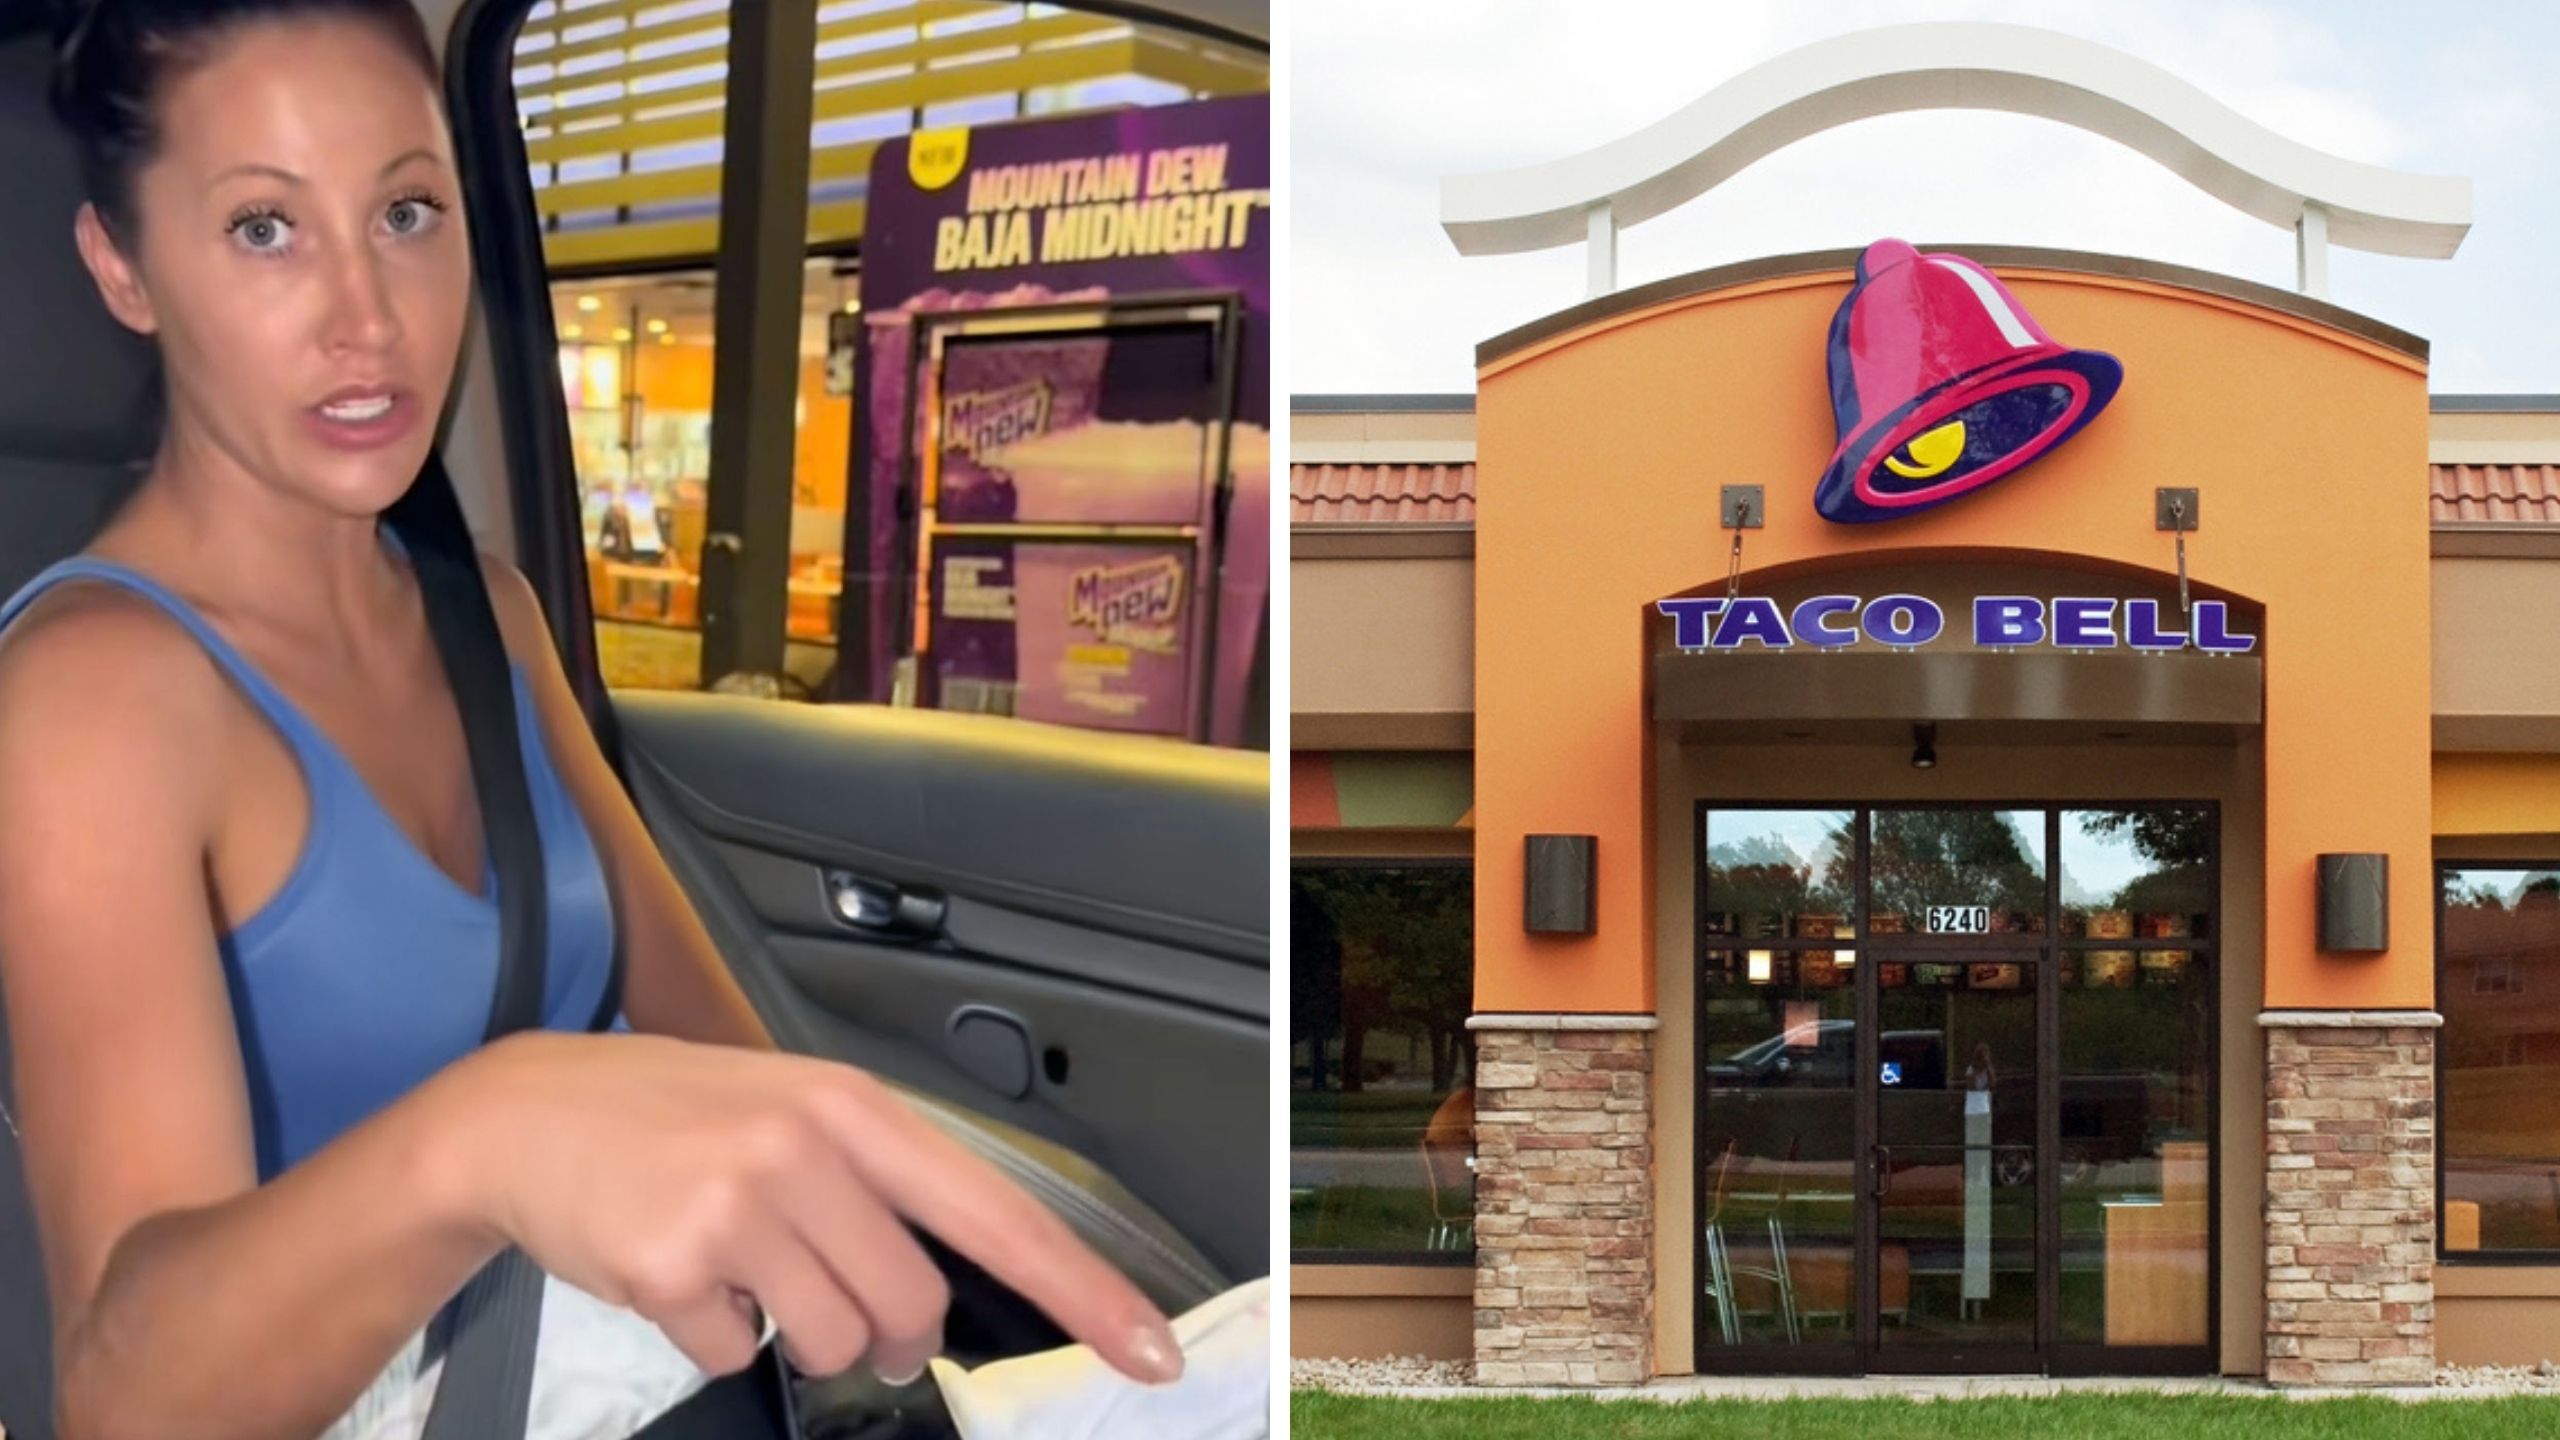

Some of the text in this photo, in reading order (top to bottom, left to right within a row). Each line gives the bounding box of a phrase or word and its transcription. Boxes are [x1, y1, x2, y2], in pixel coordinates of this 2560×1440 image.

[967, 143, 1228, 214] MOUNTAIN DEW
[934, 211, 1032, 271] BAJA
[1656, 594, 2257, 651] TACO BELL
[1930, 907, 1986, 932] 6240
